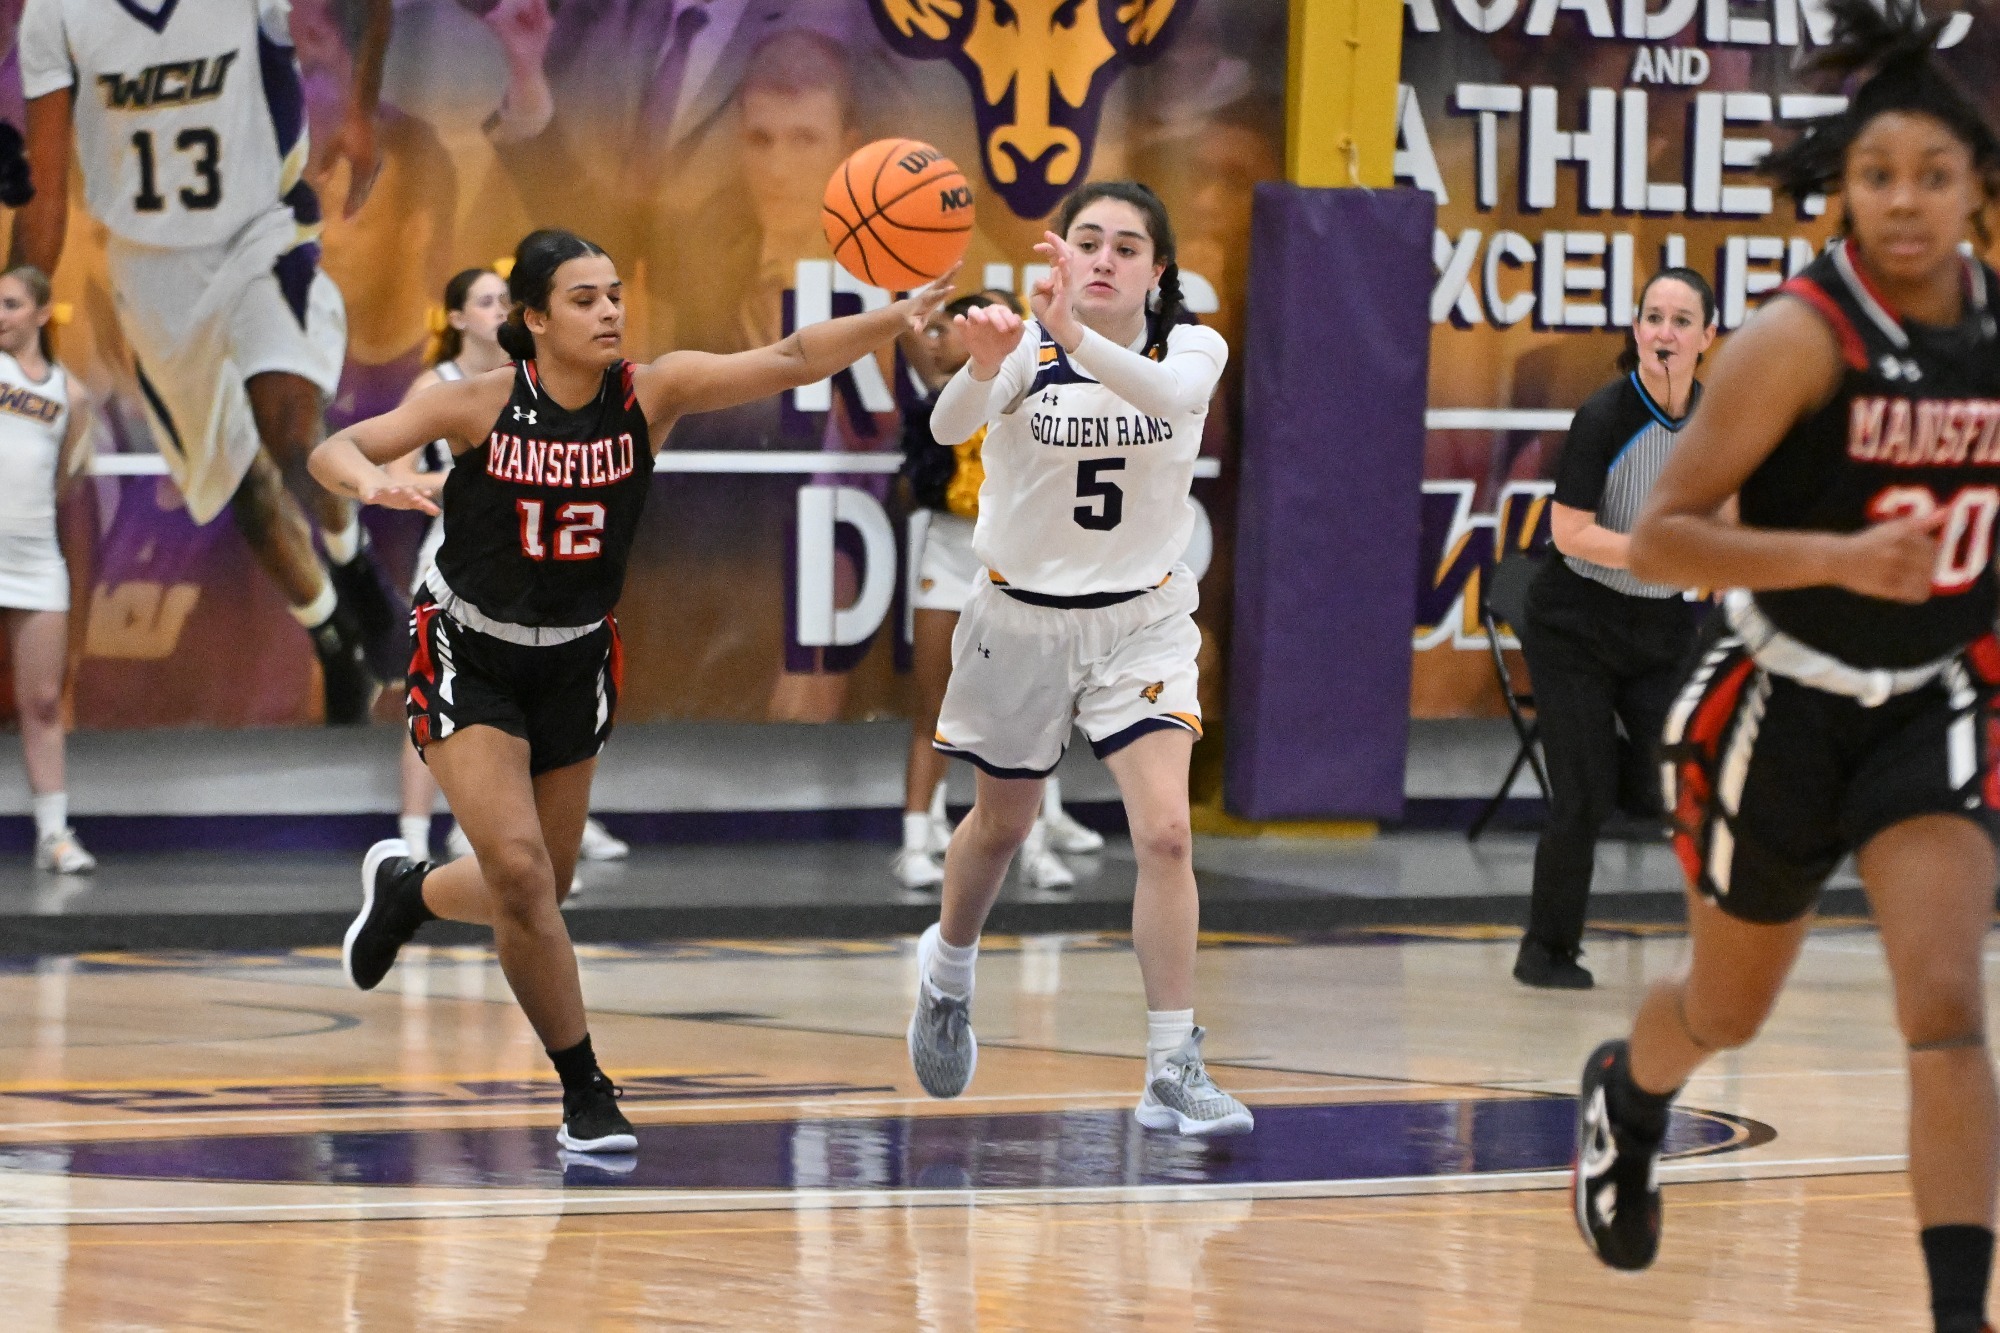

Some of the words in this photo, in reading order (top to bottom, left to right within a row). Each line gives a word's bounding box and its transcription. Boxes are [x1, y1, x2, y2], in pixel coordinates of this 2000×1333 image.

[97, 48, 239, 112] WCU
[1631, 44, 1711, 85] AND
[132, 128, 221, 212] 13
[486, 431, 634, 488] MANSFIELD
[1031, 412, 1109, 447] GOLDEN
[1116, 414, 1173, 446] RAMS
[1073, 457, 1127, 531] 5
[515, 498, 607, 561] 12
